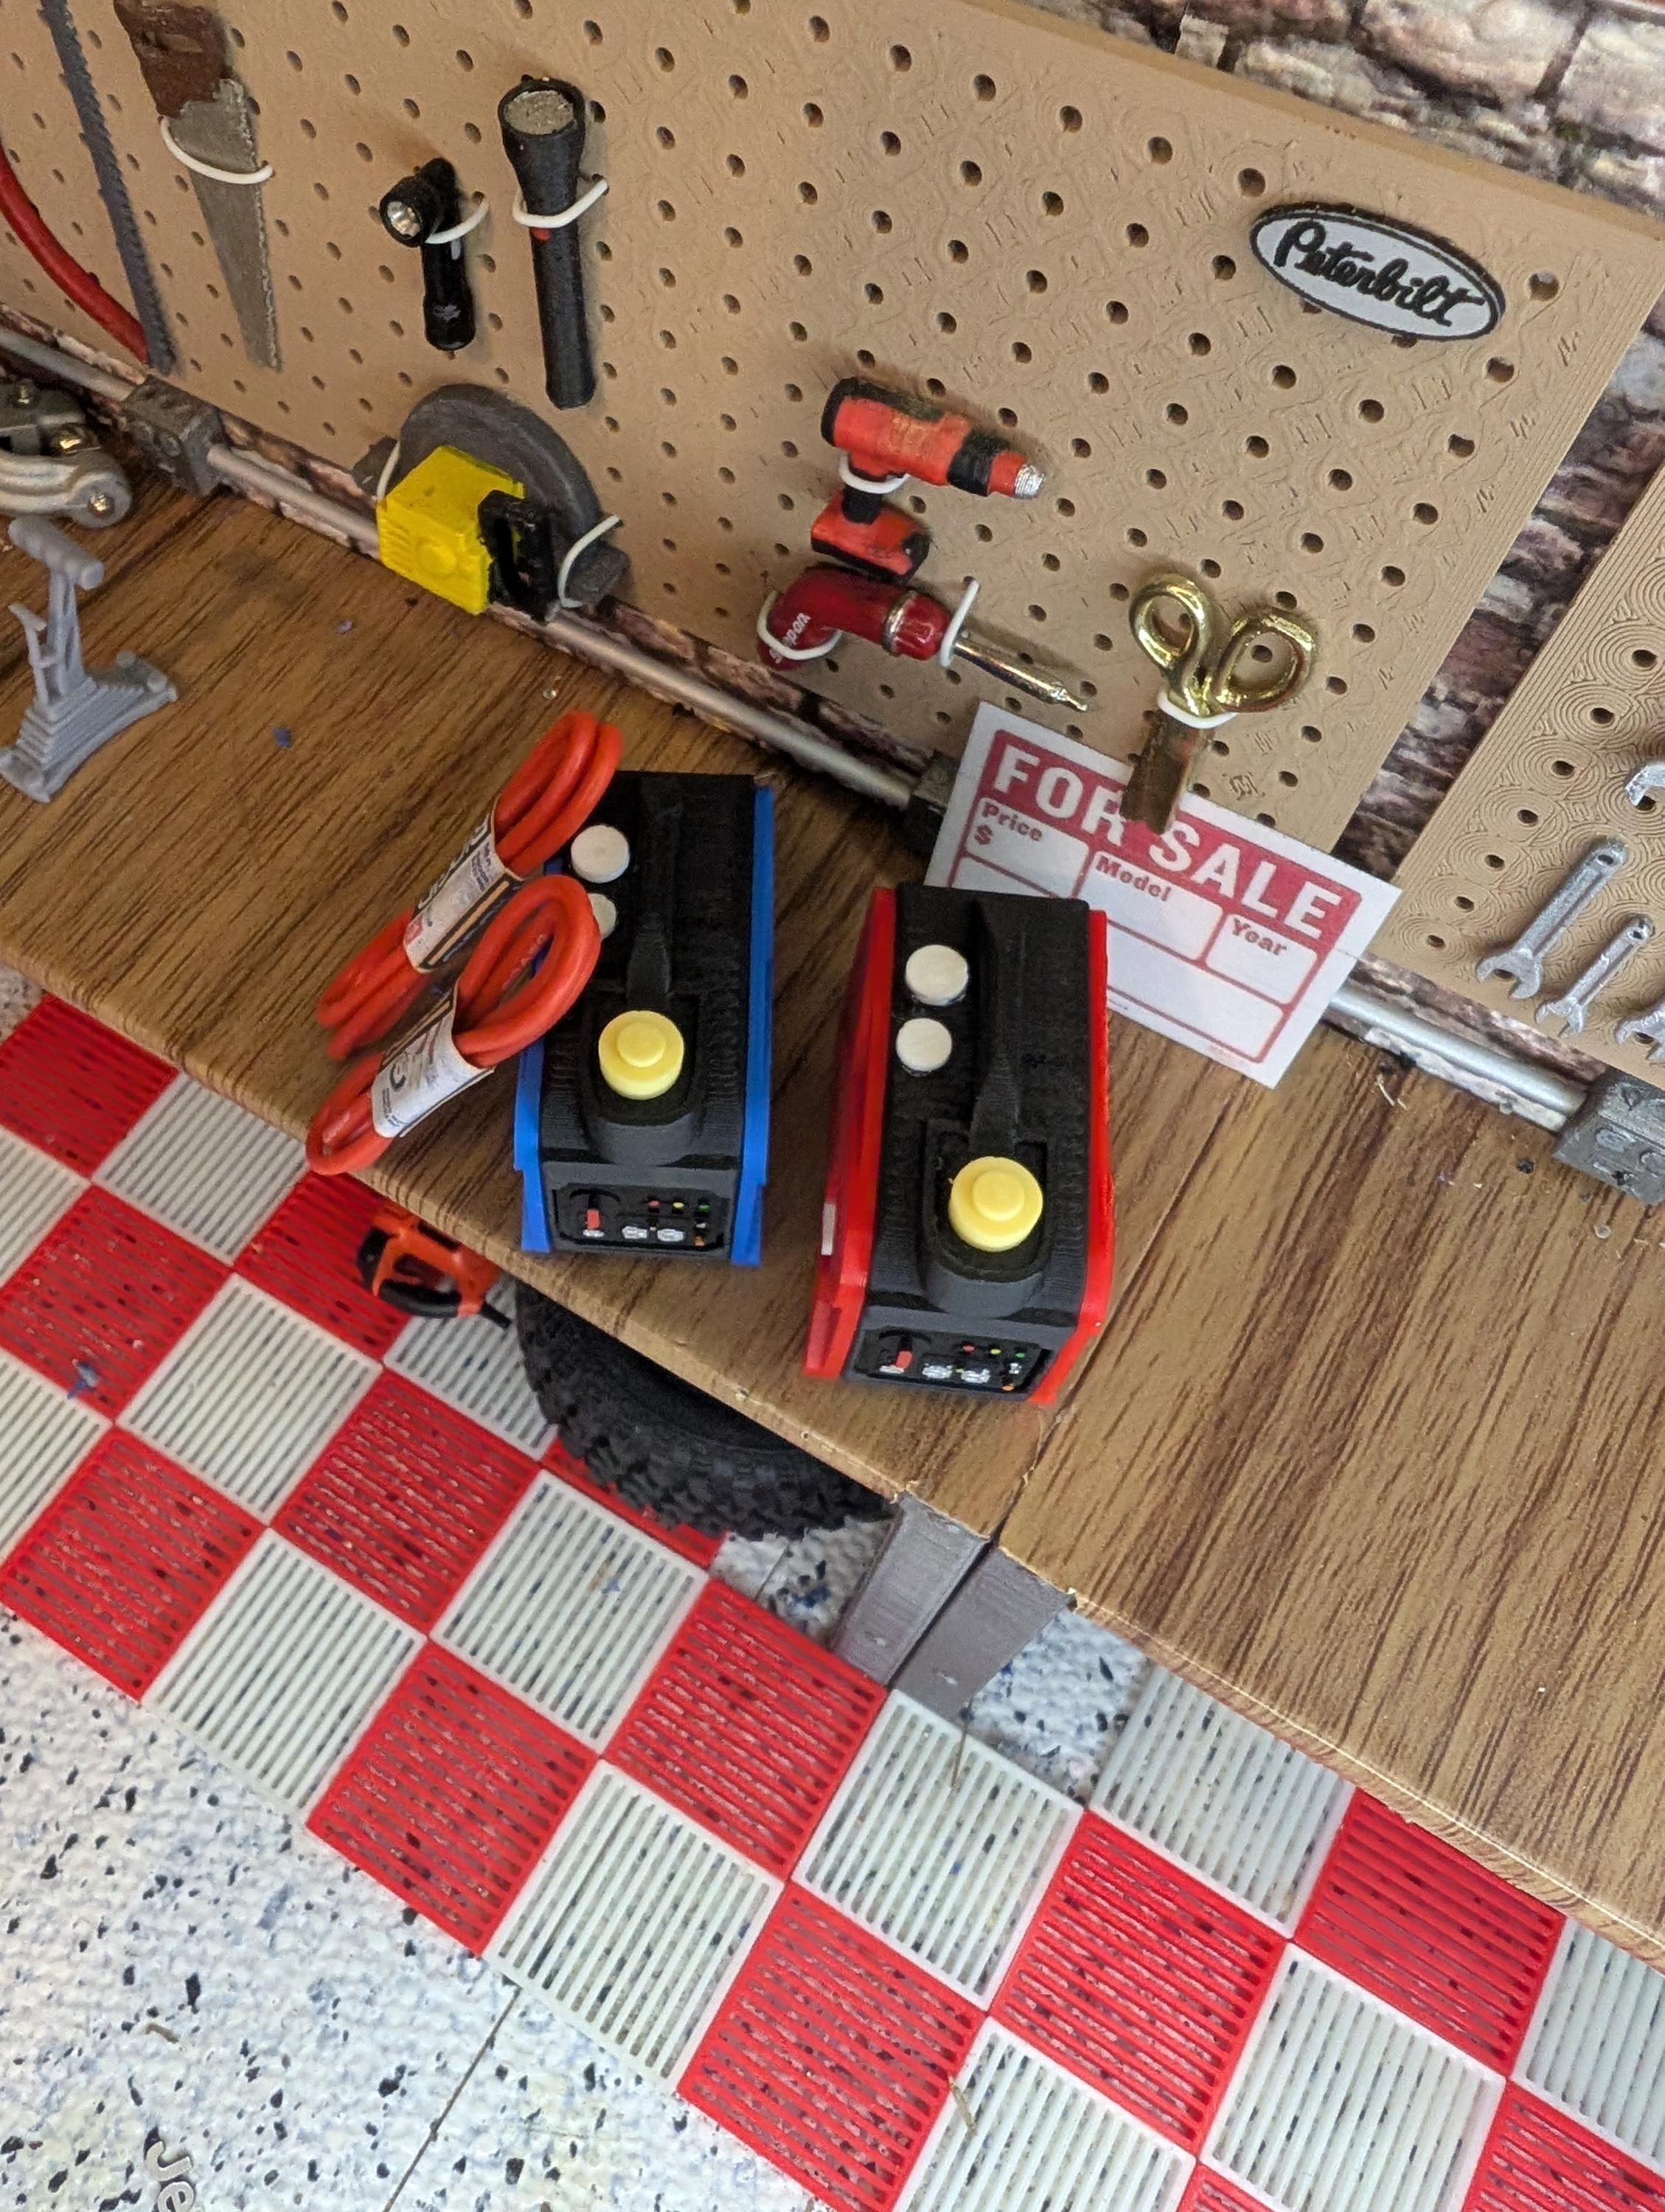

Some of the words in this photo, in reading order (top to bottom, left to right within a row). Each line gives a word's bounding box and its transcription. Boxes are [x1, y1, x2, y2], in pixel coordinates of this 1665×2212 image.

[1273, 220, 1485, 327] Peterbilt
[974, 824, 993, 845] $
[981, 801, 1043, 841] Price
[994, 745, 1125, 846] FOR
[1149, 820, 1342, 939] SALE
[1095, 855, 1172, 902] Model
[1231, 917, 1287, 956] Year
